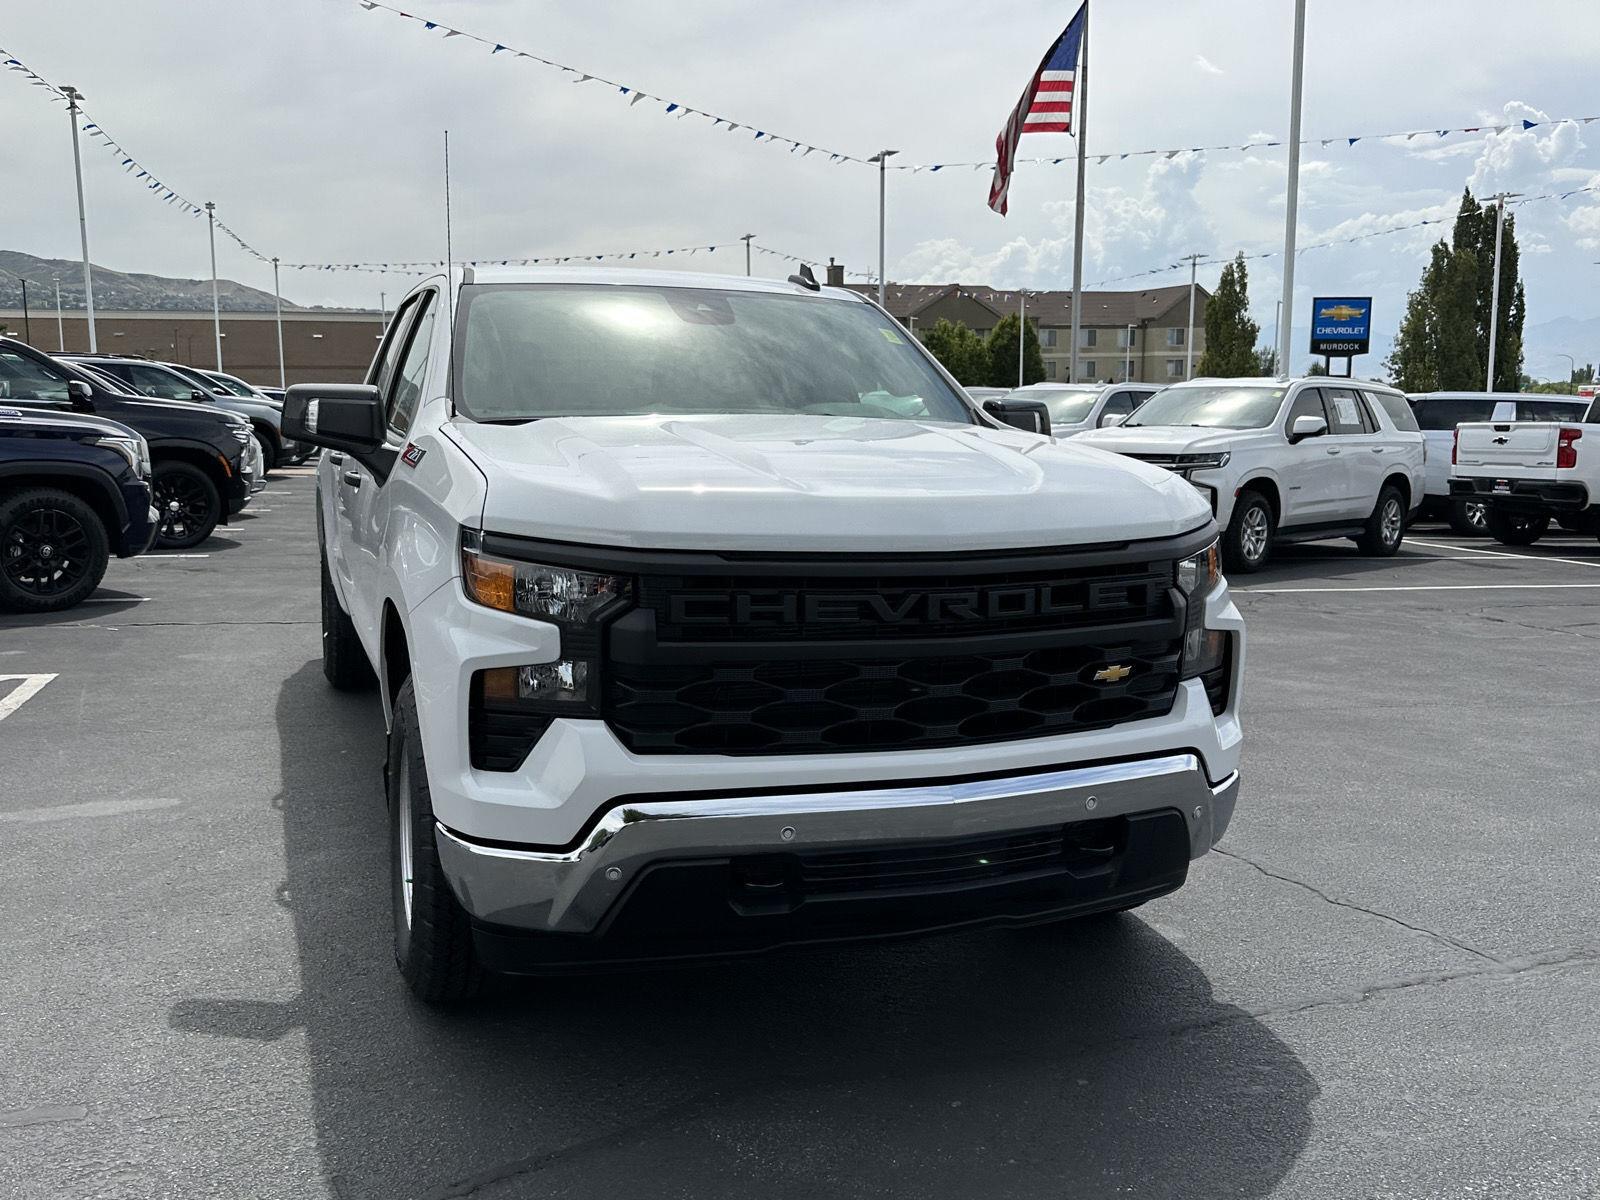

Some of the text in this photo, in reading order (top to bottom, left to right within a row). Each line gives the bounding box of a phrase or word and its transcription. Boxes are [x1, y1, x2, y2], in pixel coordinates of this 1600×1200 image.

[1316, 327, 1365, 335] CHEVROLET
[1319, 343, 1360, 351] MURDOCK
[669, 577, 1169, 625] CHEVROLET
